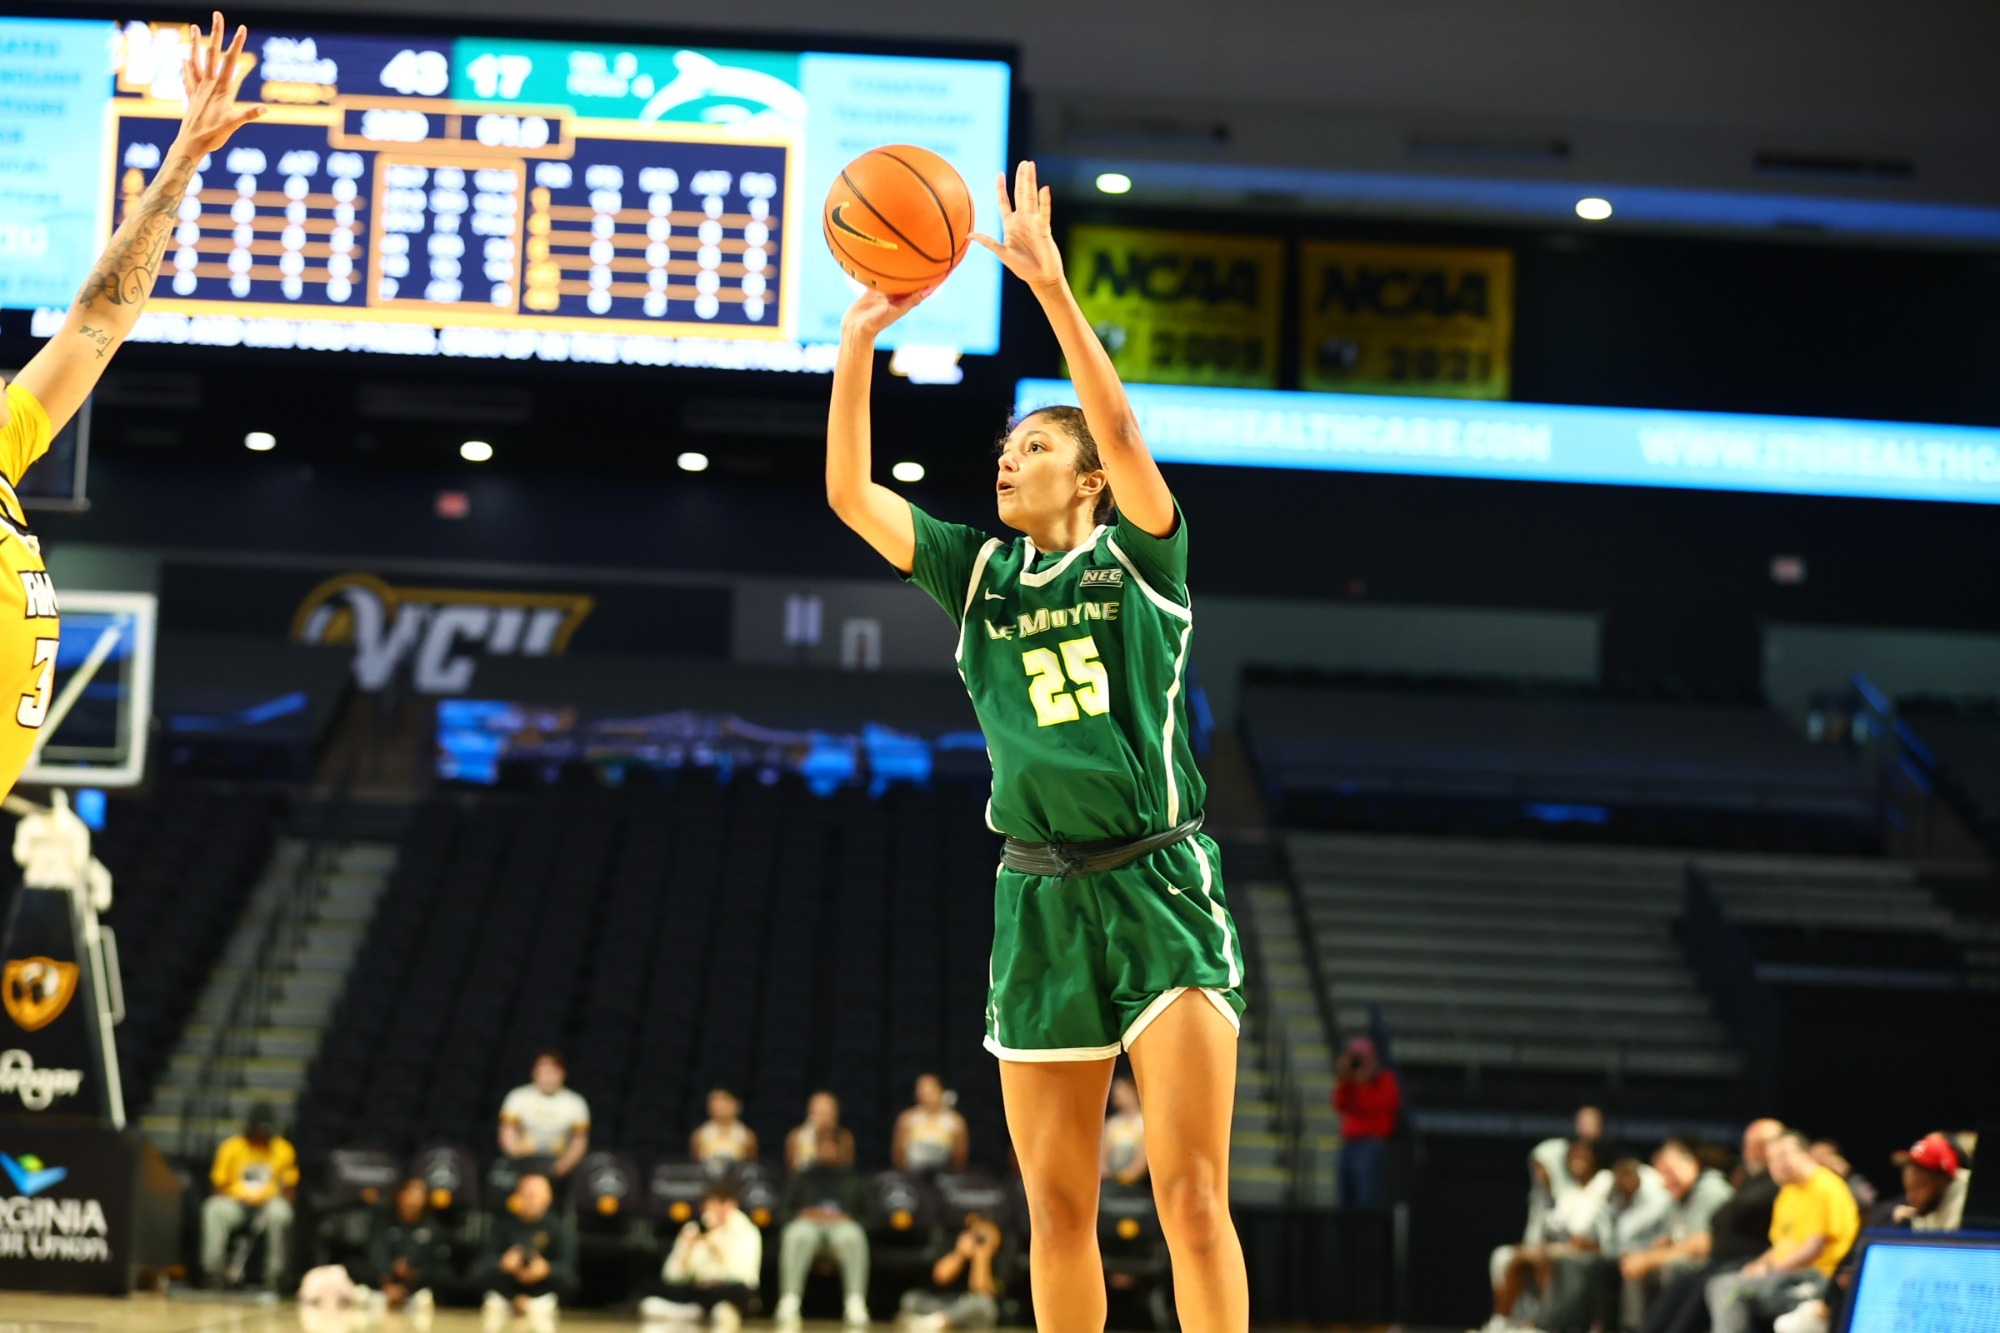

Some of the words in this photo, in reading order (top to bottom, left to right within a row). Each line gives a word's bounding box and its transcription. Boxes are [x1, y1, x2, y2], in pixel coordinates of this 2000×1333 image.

[380, 50, 449, 96] 43
[466, 53, 532, 99] 17
[1088, 249, 1260, 308] NCAA
[1318, 264, 1490, 317] NCAA
[1083, 569, 1122, 582] NEC
[1022, 635, 1110, 727] 25
